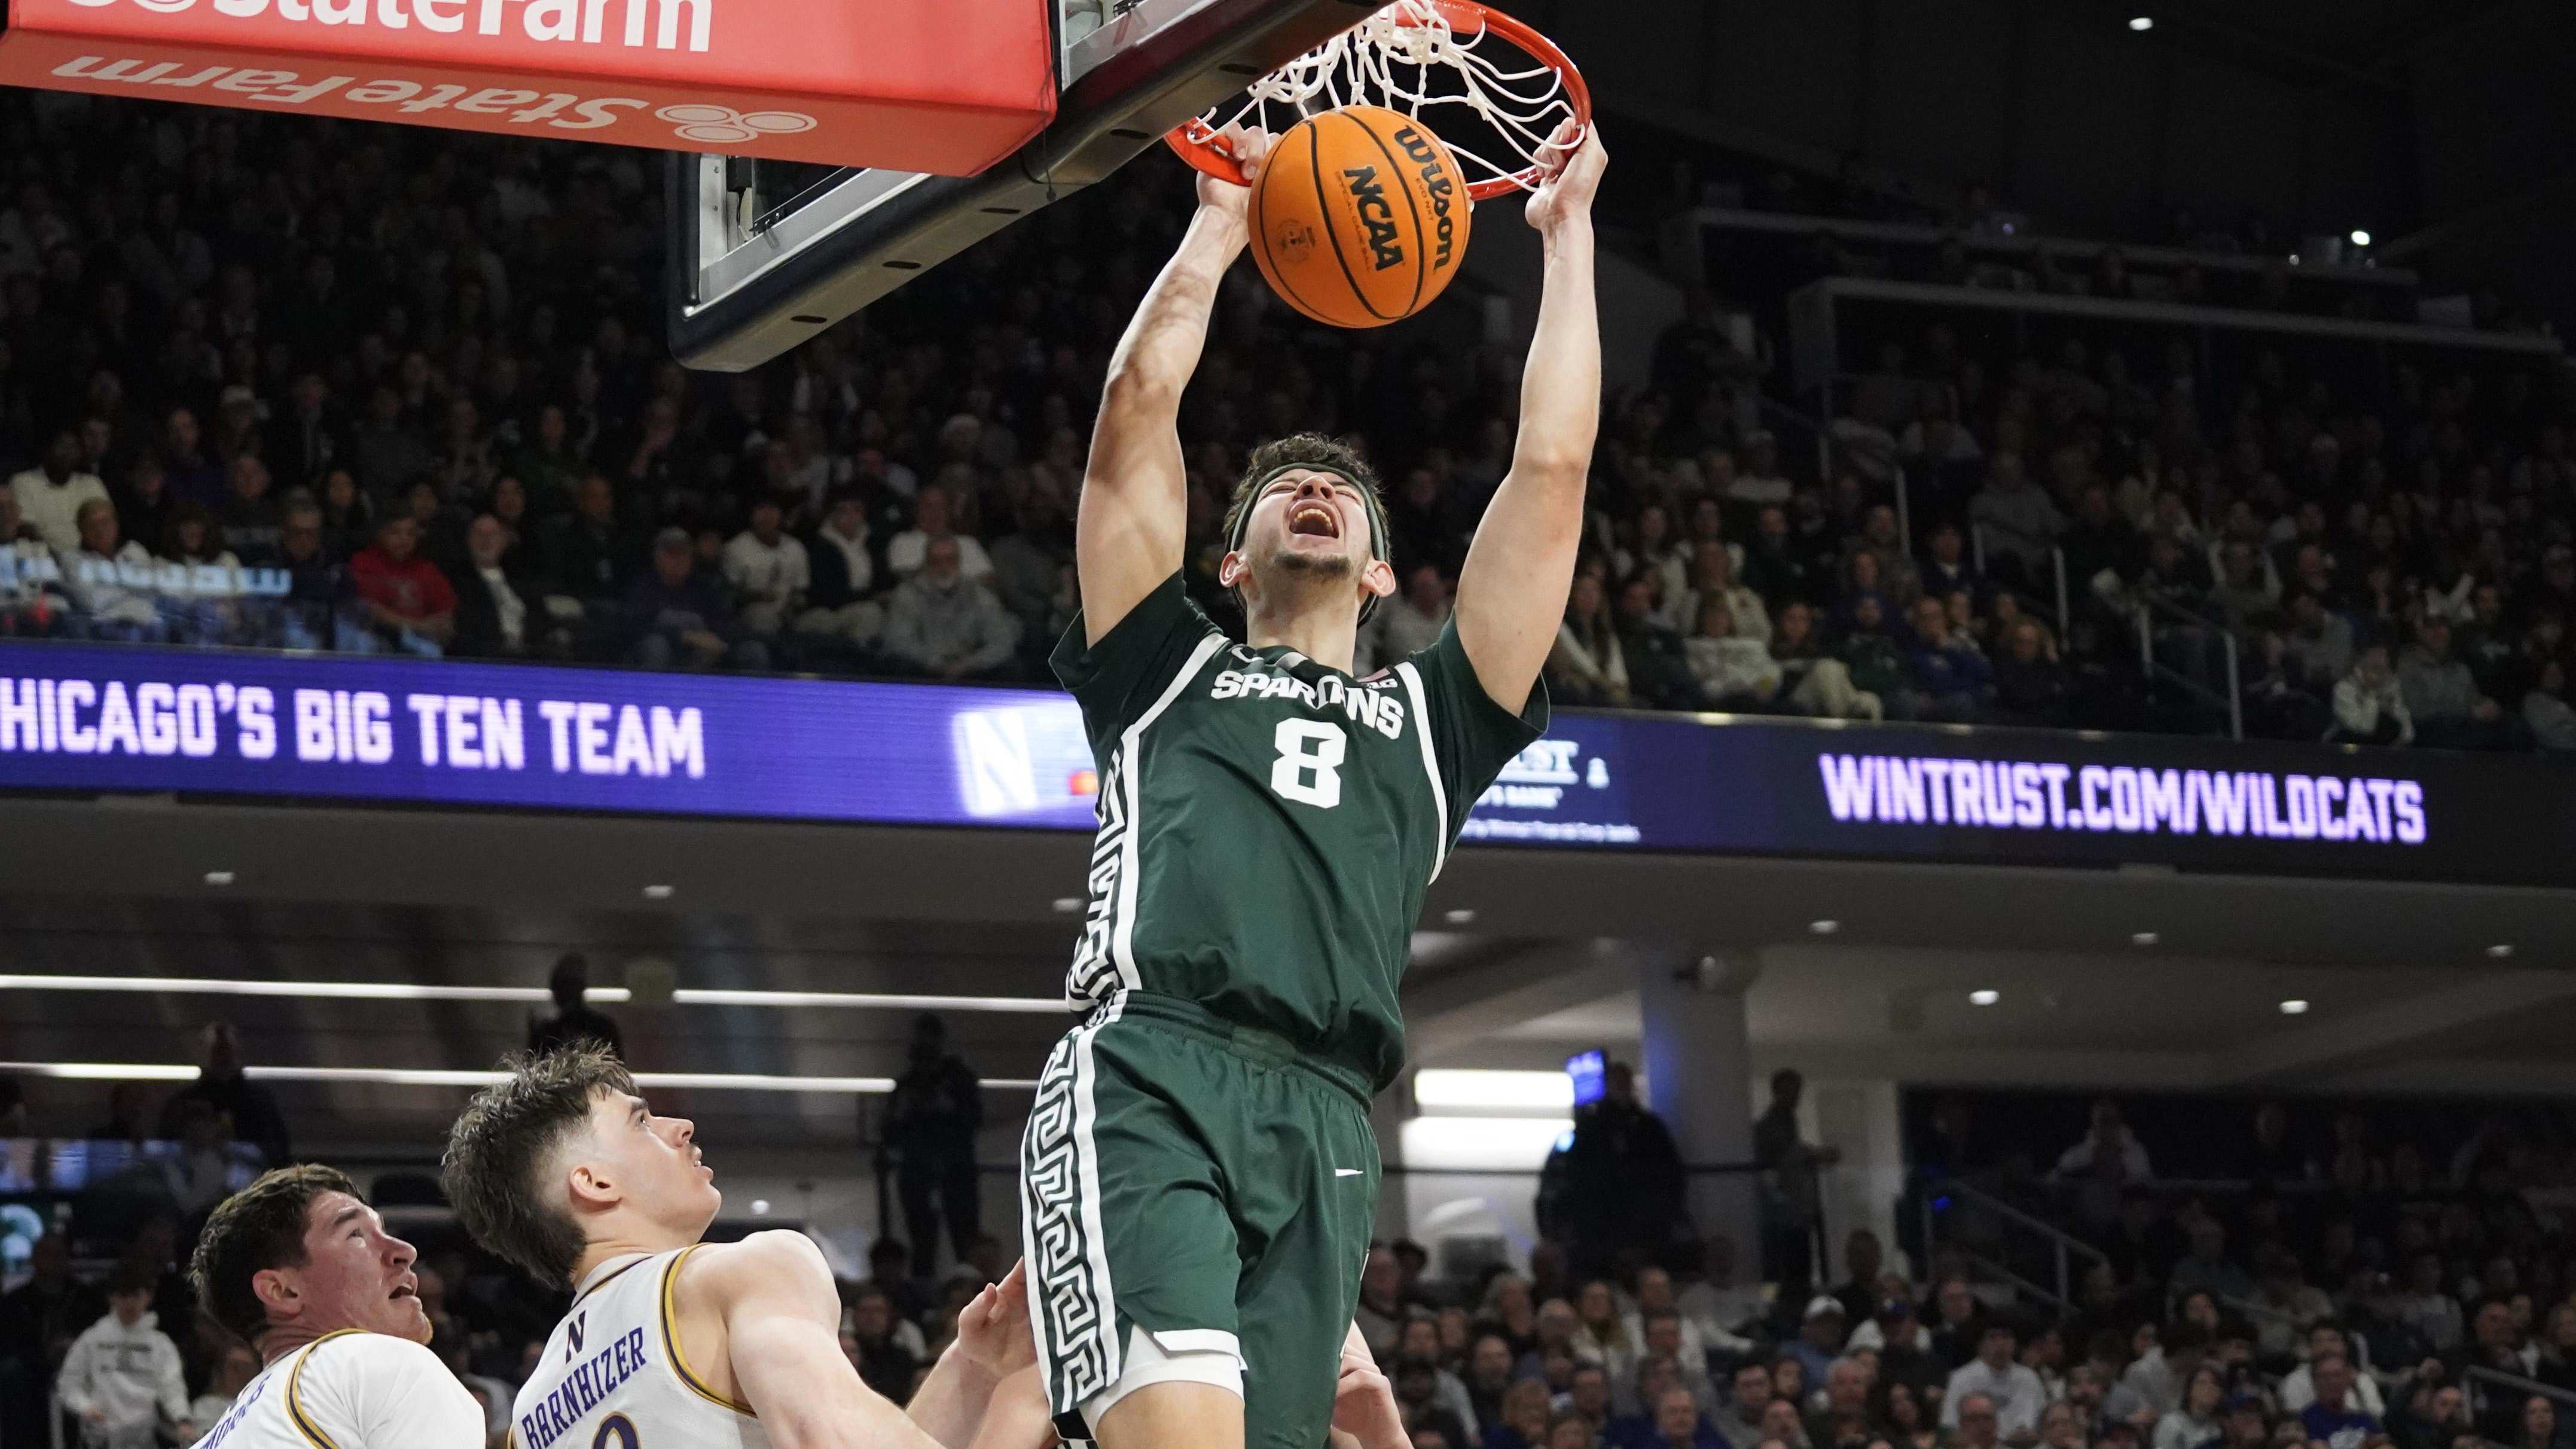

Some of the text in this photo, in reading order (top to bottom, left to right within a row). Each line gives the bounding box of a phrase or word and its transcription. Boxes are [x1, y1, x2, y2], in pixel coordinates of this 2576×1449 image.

[1344, 164, 1404, 271] NCAA
[1394, 124, 1453, 274] Wilson
[0, 677, 706, 779] HICAGO'S BIG TEN TEAM
[1271, 717, 1347, 809] 8
[1818, 754, 2426, 843] WINTRUST.COM/WILDCATS
[521, 1326, 646, 1449] BARNHIZER
[565, 1309, 587, 1366] N
